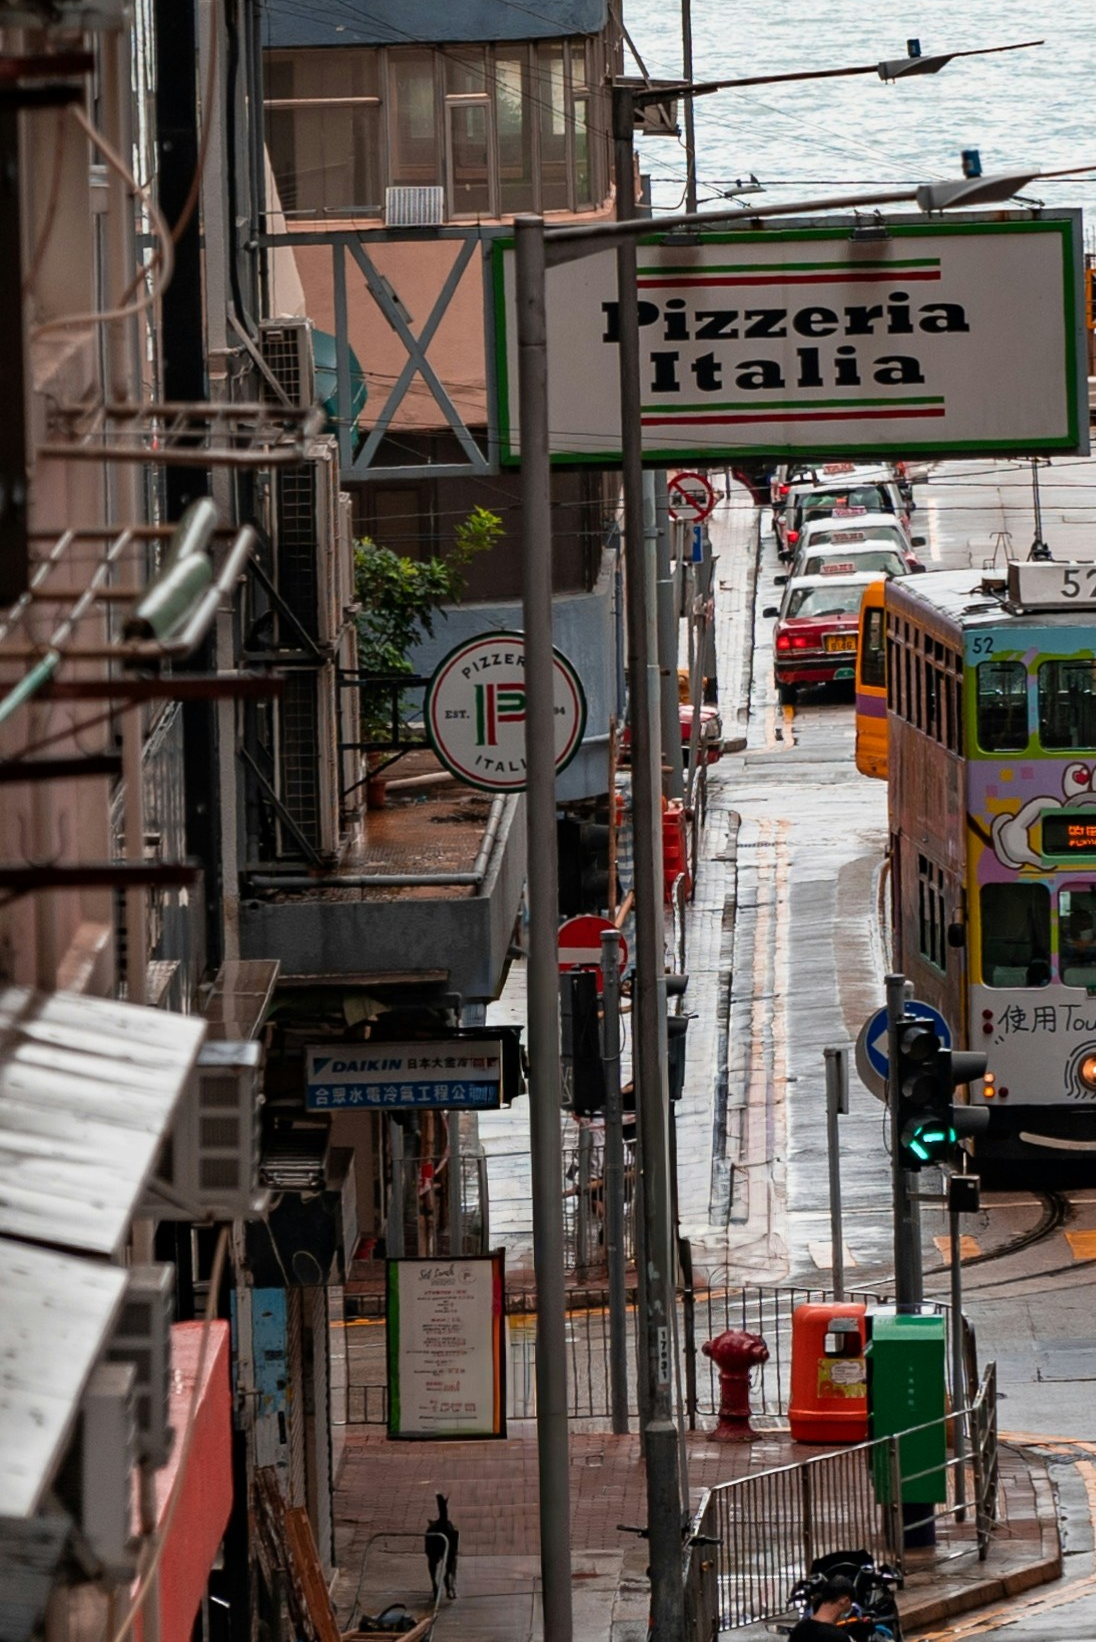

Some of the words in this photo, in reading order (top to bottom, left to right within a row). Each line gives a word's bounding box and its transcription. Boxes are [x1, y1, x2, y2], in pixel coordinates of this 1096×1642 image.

[602, 291, 970, 343] Pizzeria
[650, 345, 925, 392] Italia
[972, 637, 994, 654] 52
[461, 653, 525, 679] PIZZER
[445, 710, 470, 719] EST.
[475, 755, 527, 772] ITALI
[331, 1059, 402, 1073] DAIKIN
